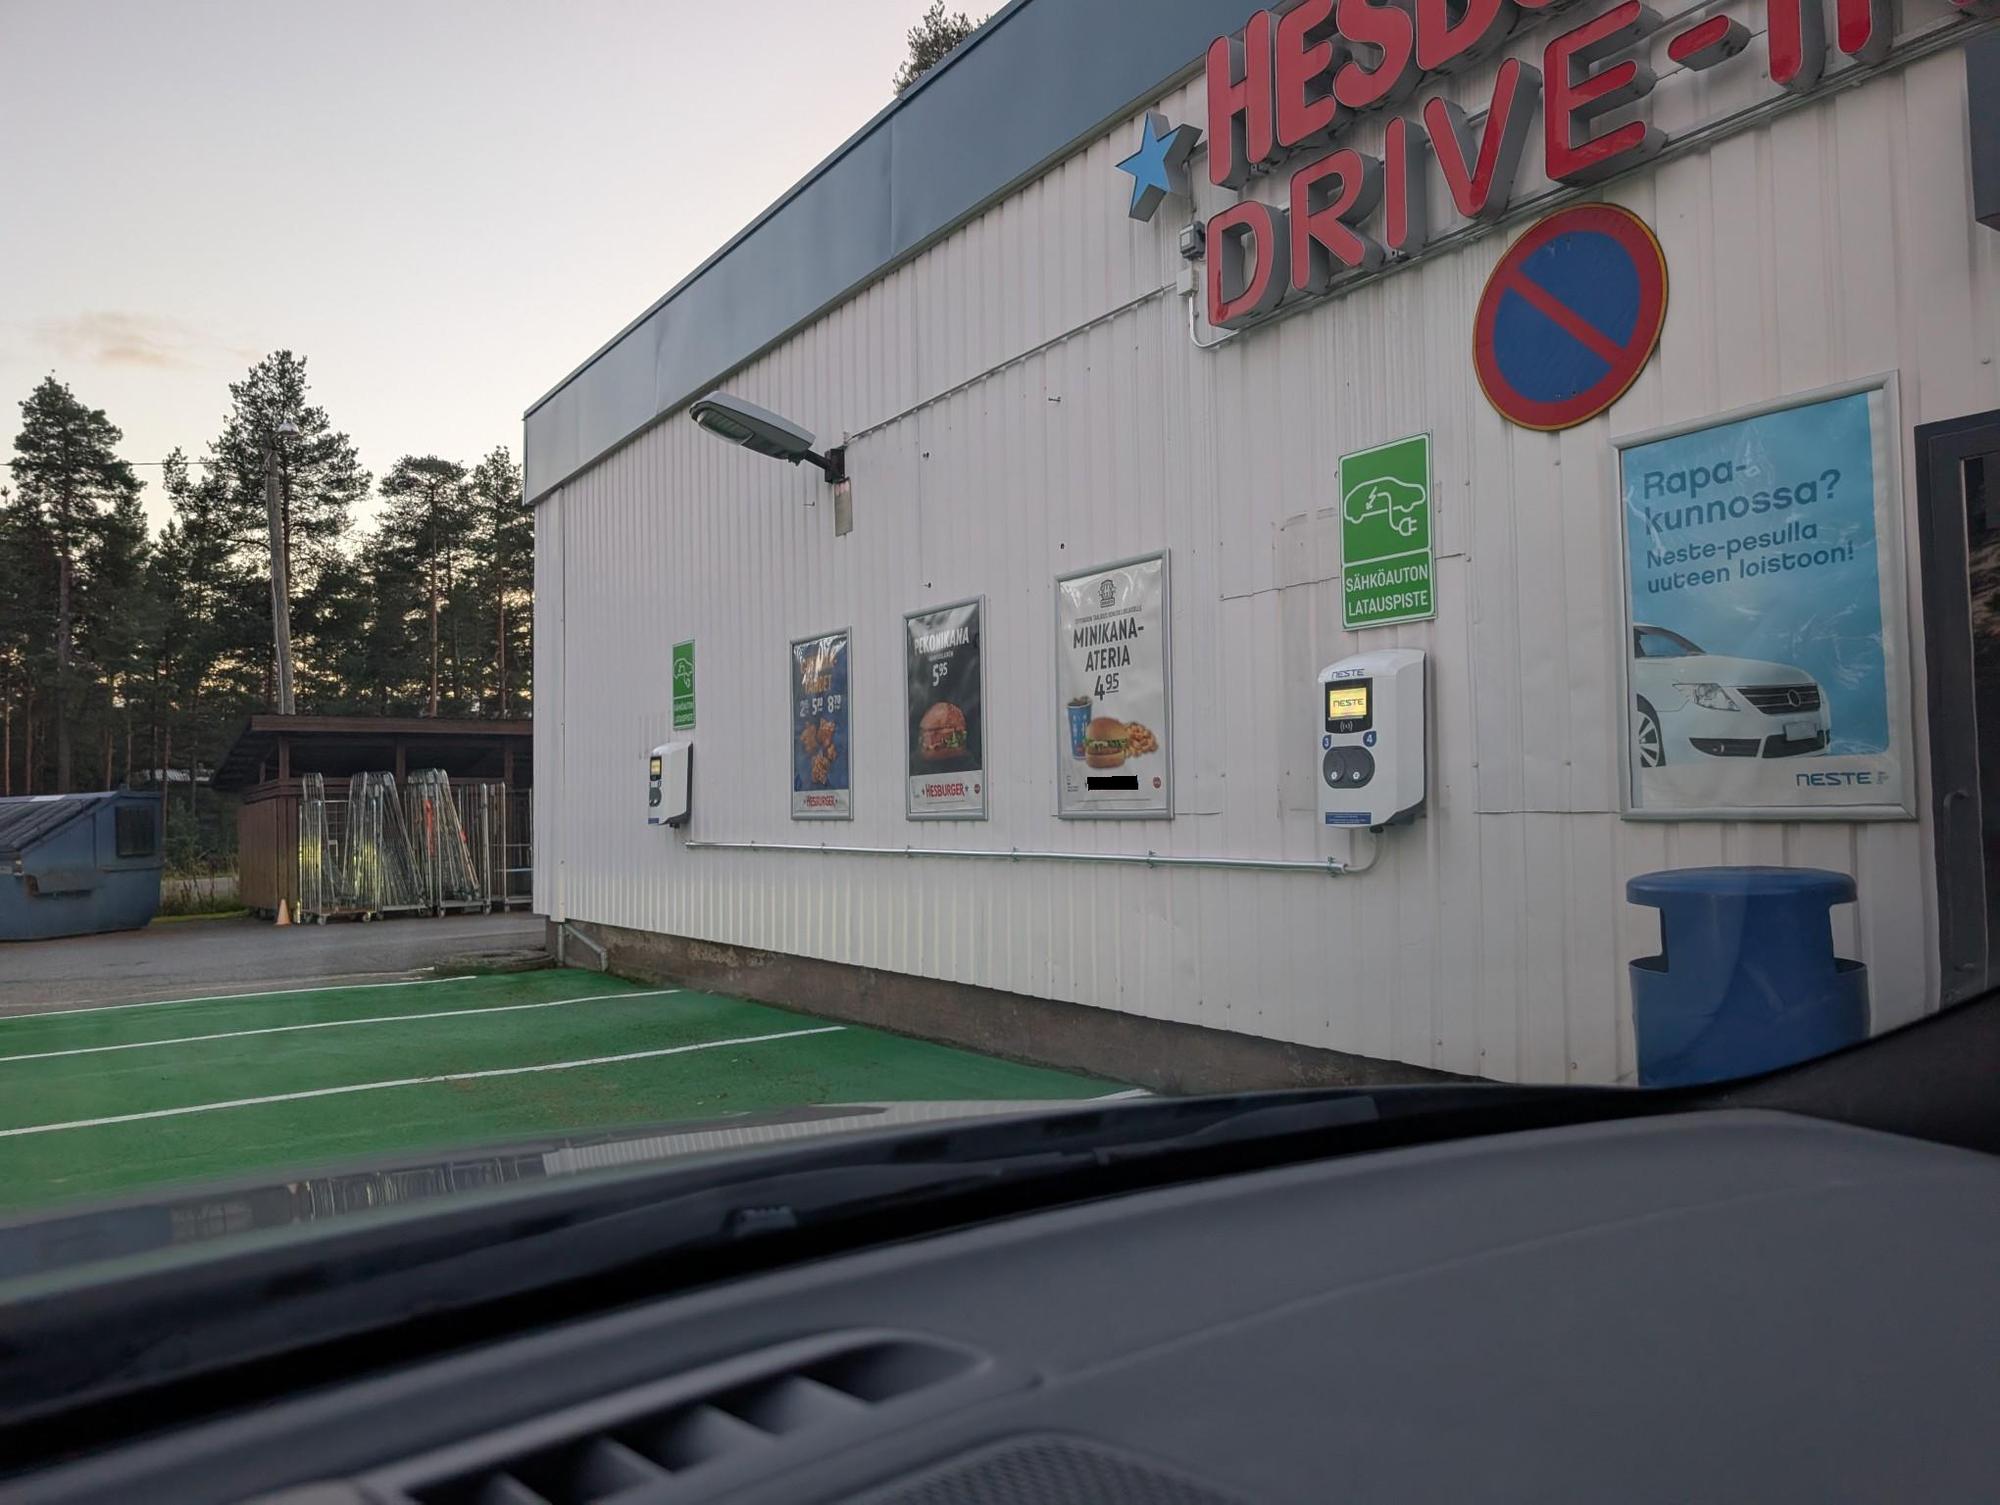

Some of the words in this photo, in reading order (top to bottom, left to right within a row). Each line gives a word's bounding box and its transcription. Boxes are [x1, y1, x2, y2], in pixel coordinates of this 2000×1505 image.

[1206, 0, 1562, 186] HES
[1643, 460, 1748, 500] Rapa-
[1644, 468, 1841, 536] kunnossa?
[1646, 520, 1818, 569] Neste-pesulla
[1345, 564, 1428, 592] SÄHKÖAUTON
[1647, 566, 1730, 594] uuteen
[1739, 540, 1854, 579] loistoon!
[1348, 590, 1428, 617] LATAUSPISTE
[1073, 617, 1144, 649] MINIKANA-
[1085, 645, 1131, 672] ATERIA
[1331, 668, 1365, 680] NESTE
[1332, 698, 1365, 709] NESTE
[925, 782, 965, 798] HESBURGER
[1795, 771, 1872, 787] NESTE
